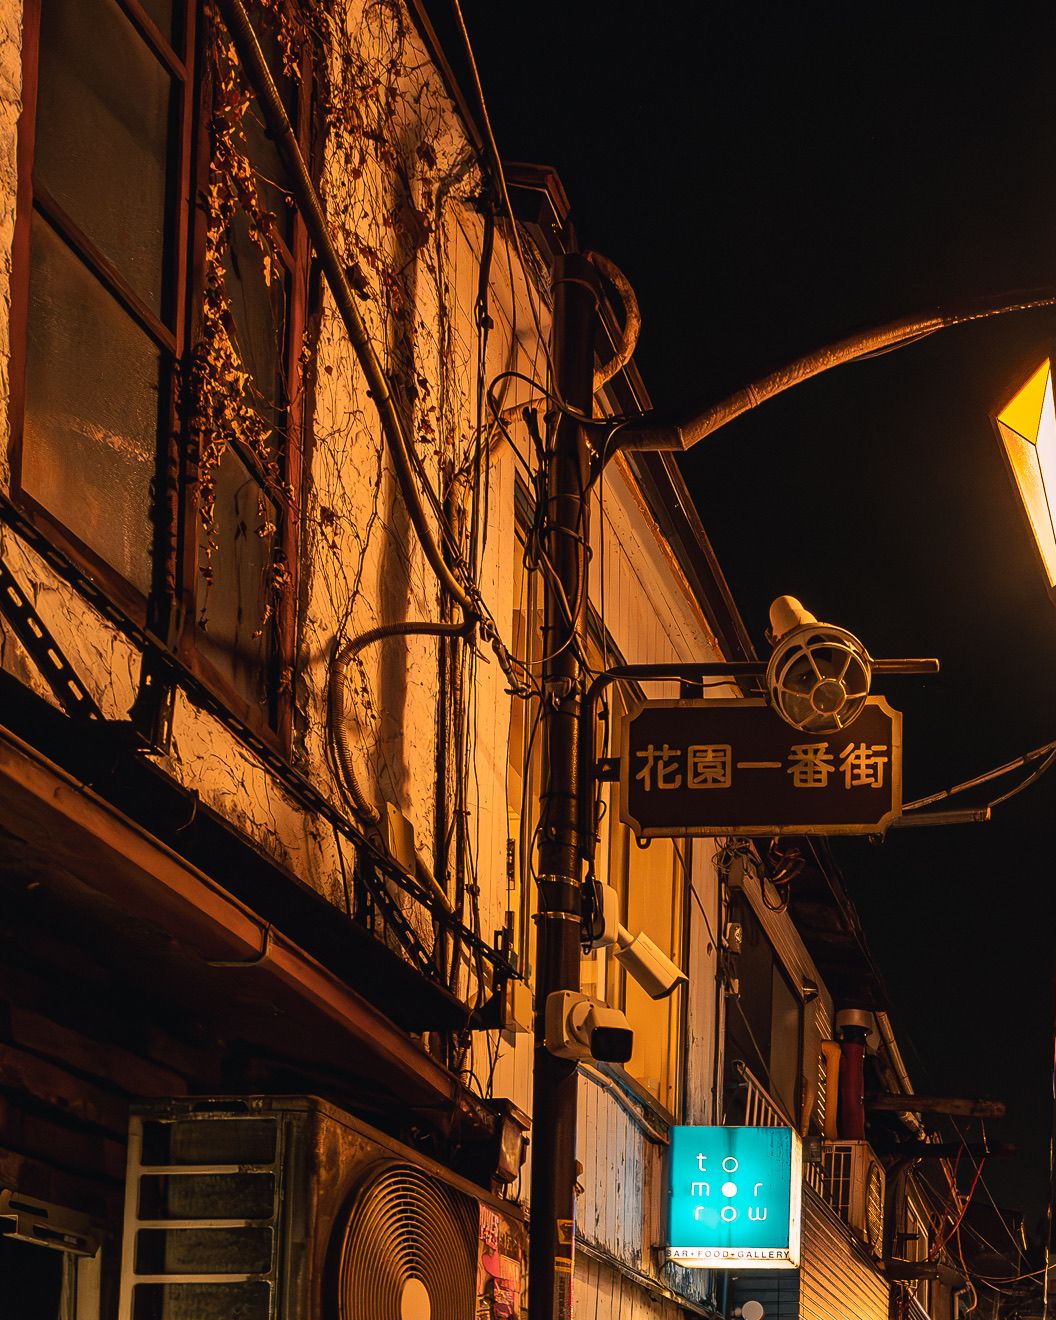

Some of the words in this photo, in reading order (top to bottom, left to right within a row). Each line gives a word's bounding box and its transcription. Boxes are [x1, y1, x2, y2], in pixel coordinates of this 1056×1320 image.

[636, 743, 888, 791] 花園一番街
